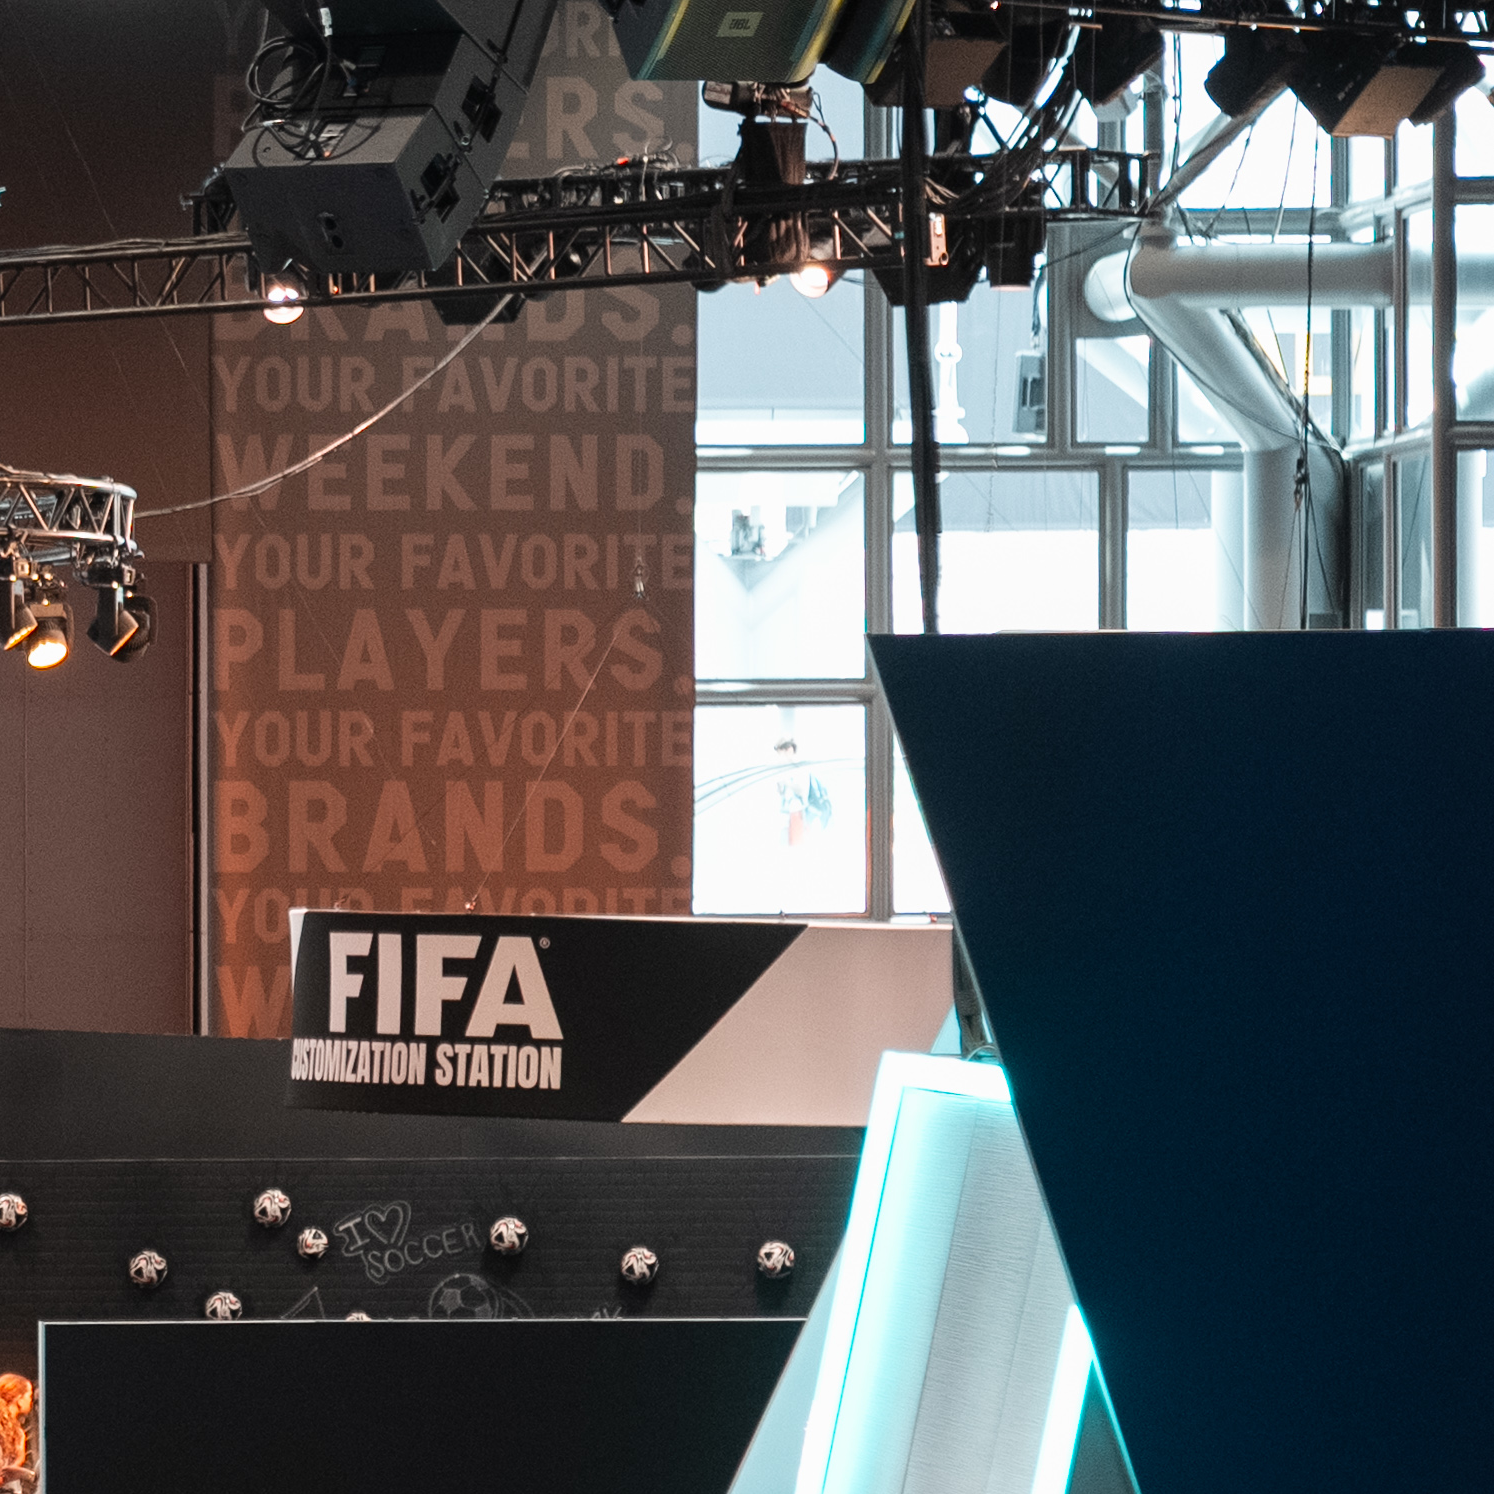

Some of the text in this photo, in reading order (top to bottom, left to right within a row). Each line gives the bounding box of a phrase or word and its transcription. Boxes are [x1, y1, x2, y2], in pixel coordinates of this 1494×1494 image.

[728, 18, 751, 30] JBL
[213, 356, 694, 413] YOUR FAVORITE
[217, 434, 696, 512] WEEKEND.
[213, 534, 694, 590] YOUR FAVORITE
[217, 608, 695, 693] PLAYERS.
[213, 711, 693, 768] YOUR FAVORITE
[216, 780, 694, 875] BRANDS.
[329, 931, 564, 1041] FIFA
[291, 1039, 562, 1090] CUSTOMIZATION STATION
[366, 1221, 481, 1280] SOCCER
